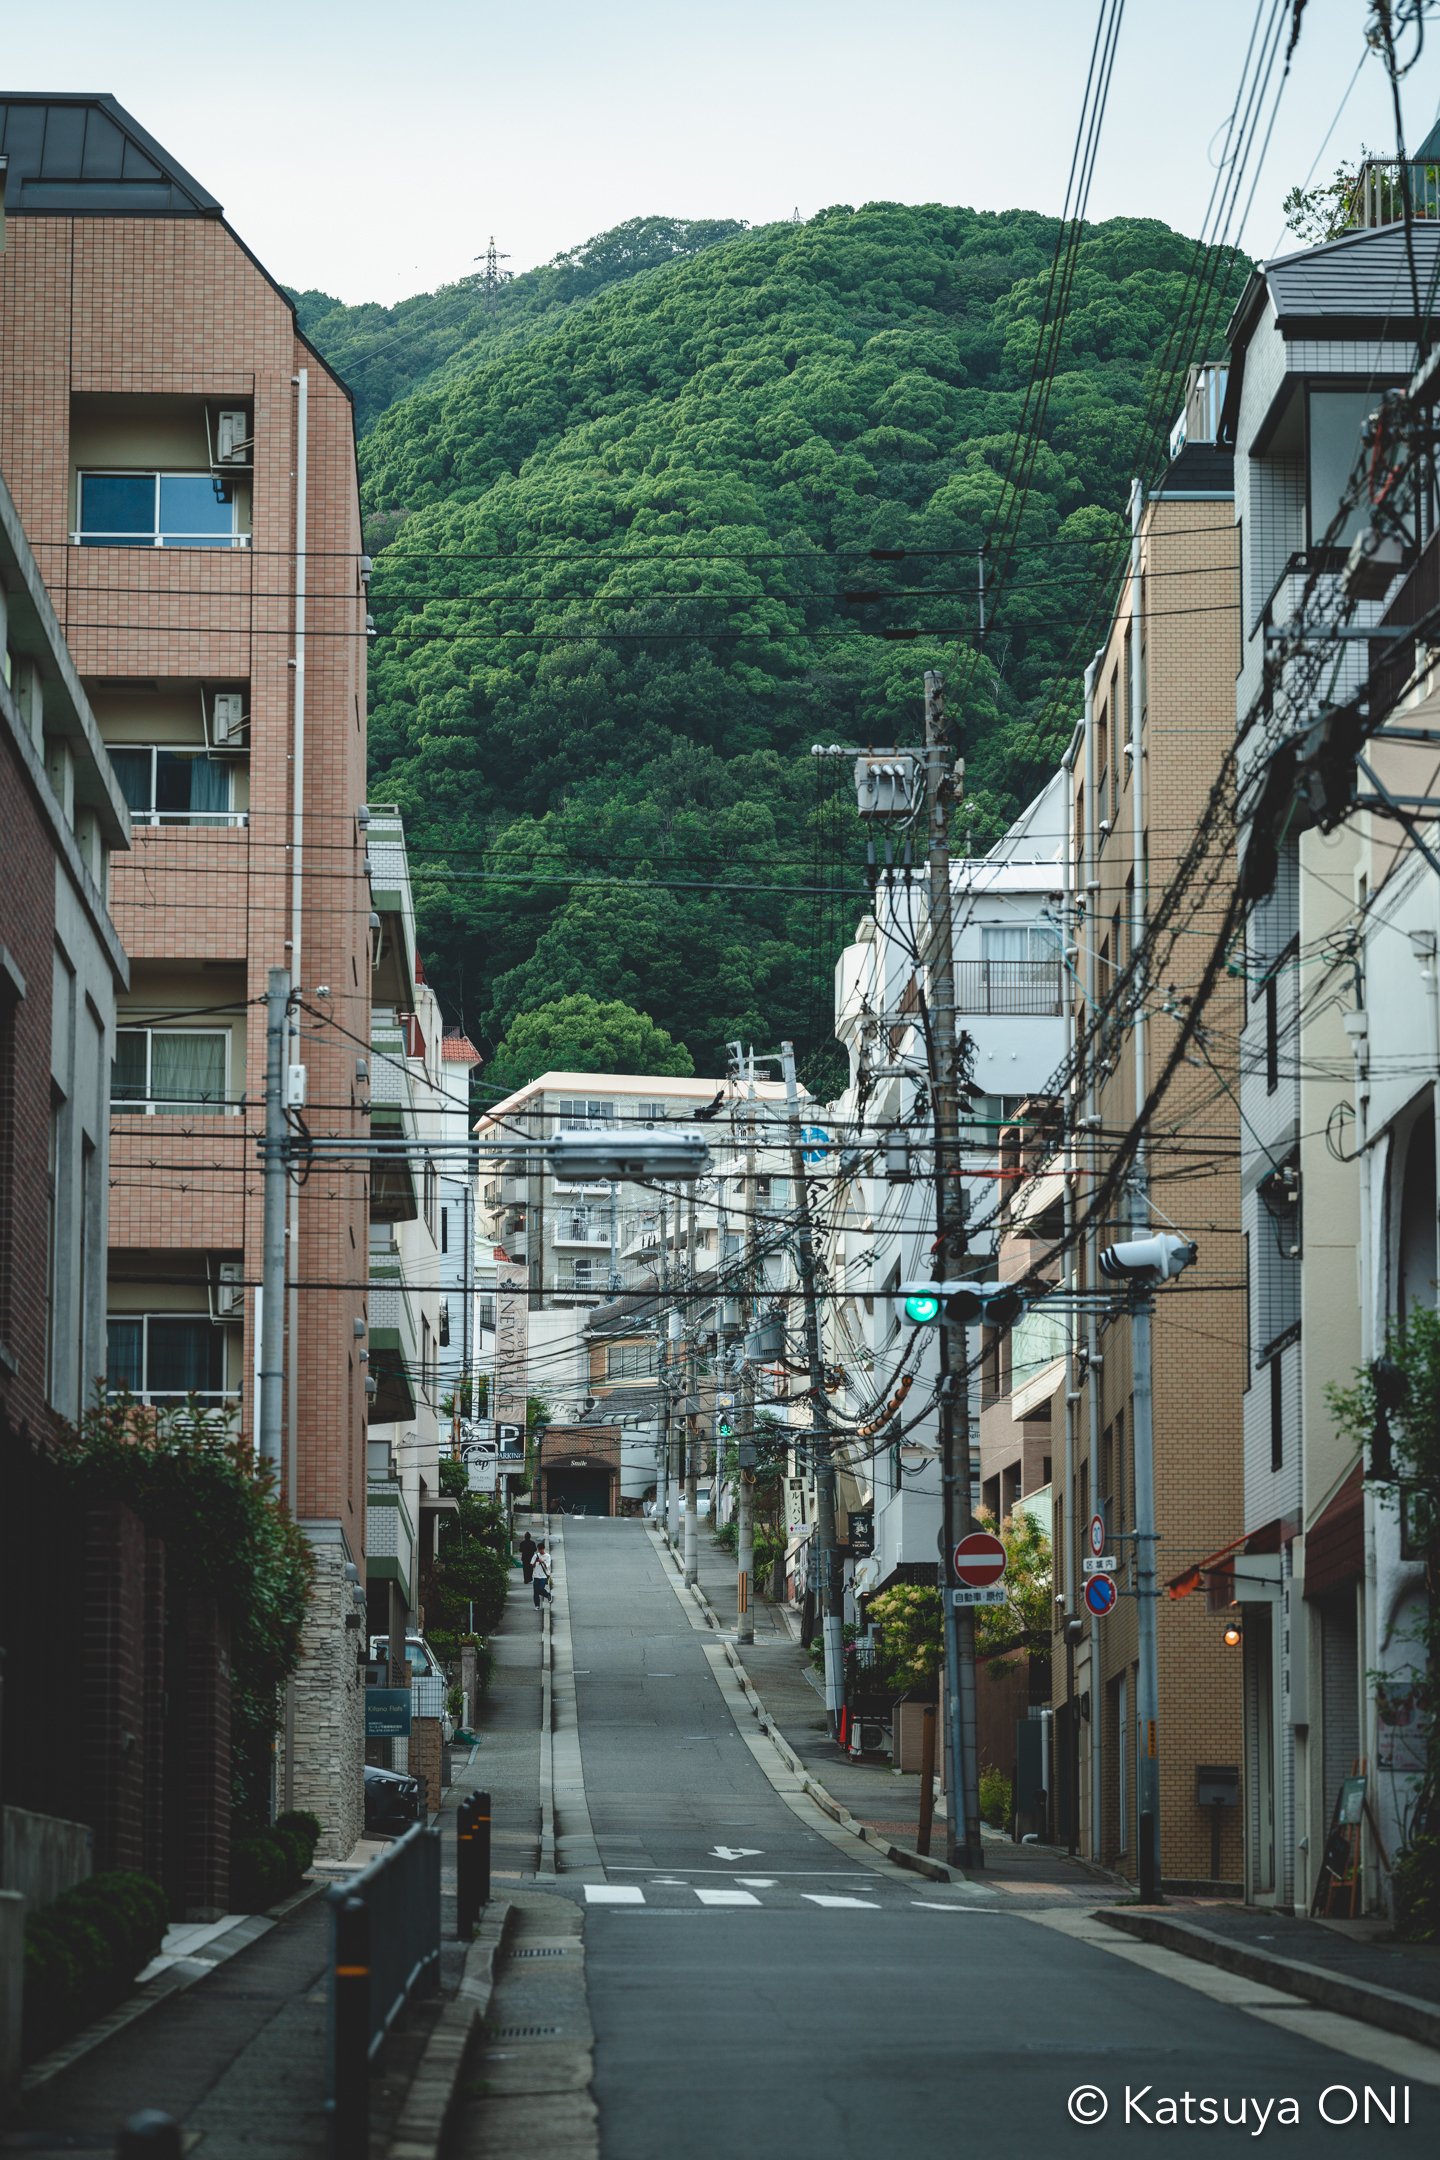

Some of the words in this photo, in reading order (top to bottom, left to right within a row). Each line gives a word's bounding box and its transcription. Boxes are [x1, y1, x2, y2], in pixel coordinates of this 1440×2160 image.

[500, 1299, 515, 1344] NEW
[517, 1327, 525, 1382] HOTEL
[498, 1349, 514, 1412] PALACE
[500, 1425, 519, 1452] P
[570, 1459, 588, 1467] Smile
[1094, 1527, 1101, 1544] 30
